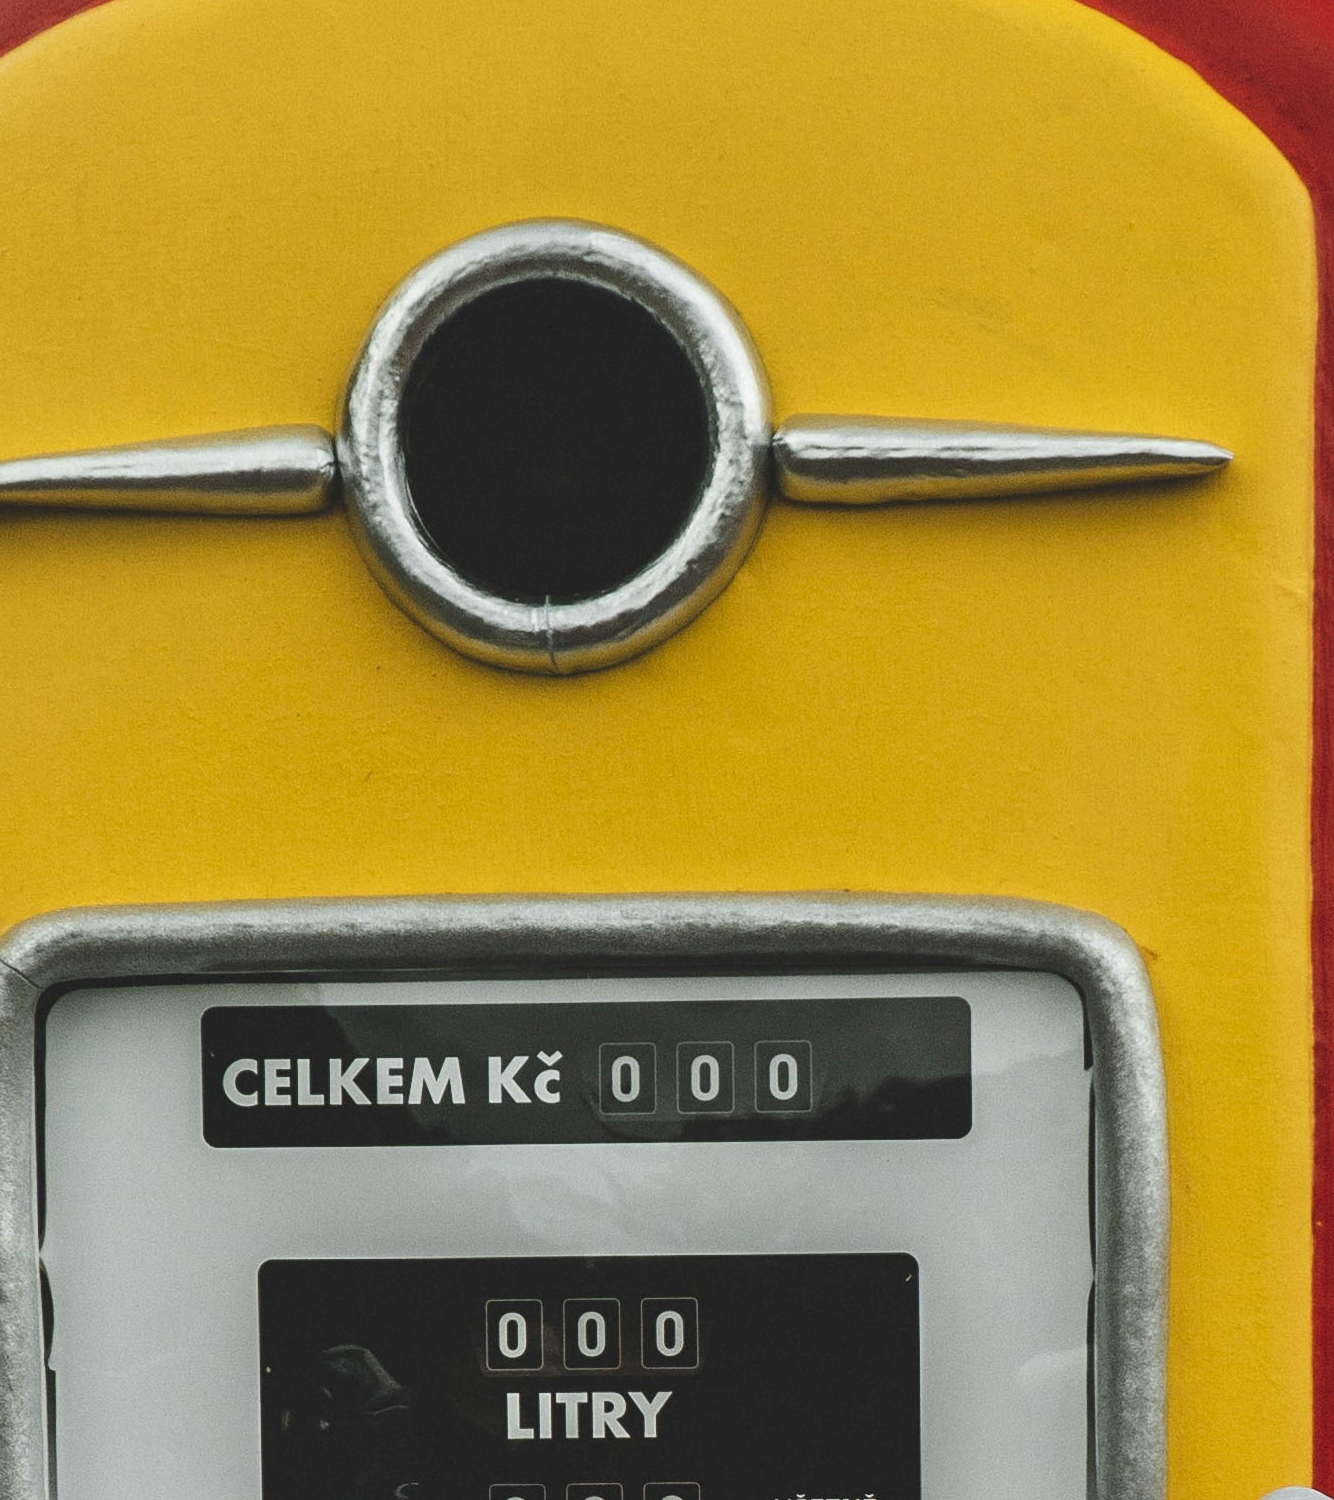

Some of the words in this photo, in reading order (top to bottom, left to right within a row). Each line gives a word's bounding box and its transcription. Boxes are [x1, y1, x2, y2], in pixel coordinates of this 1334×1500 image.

[221, 1056, 466, 1108] CELKEM
[487, 1050, 564, 1105] Kč
[505, 1390, 673, 1441] LITRY
